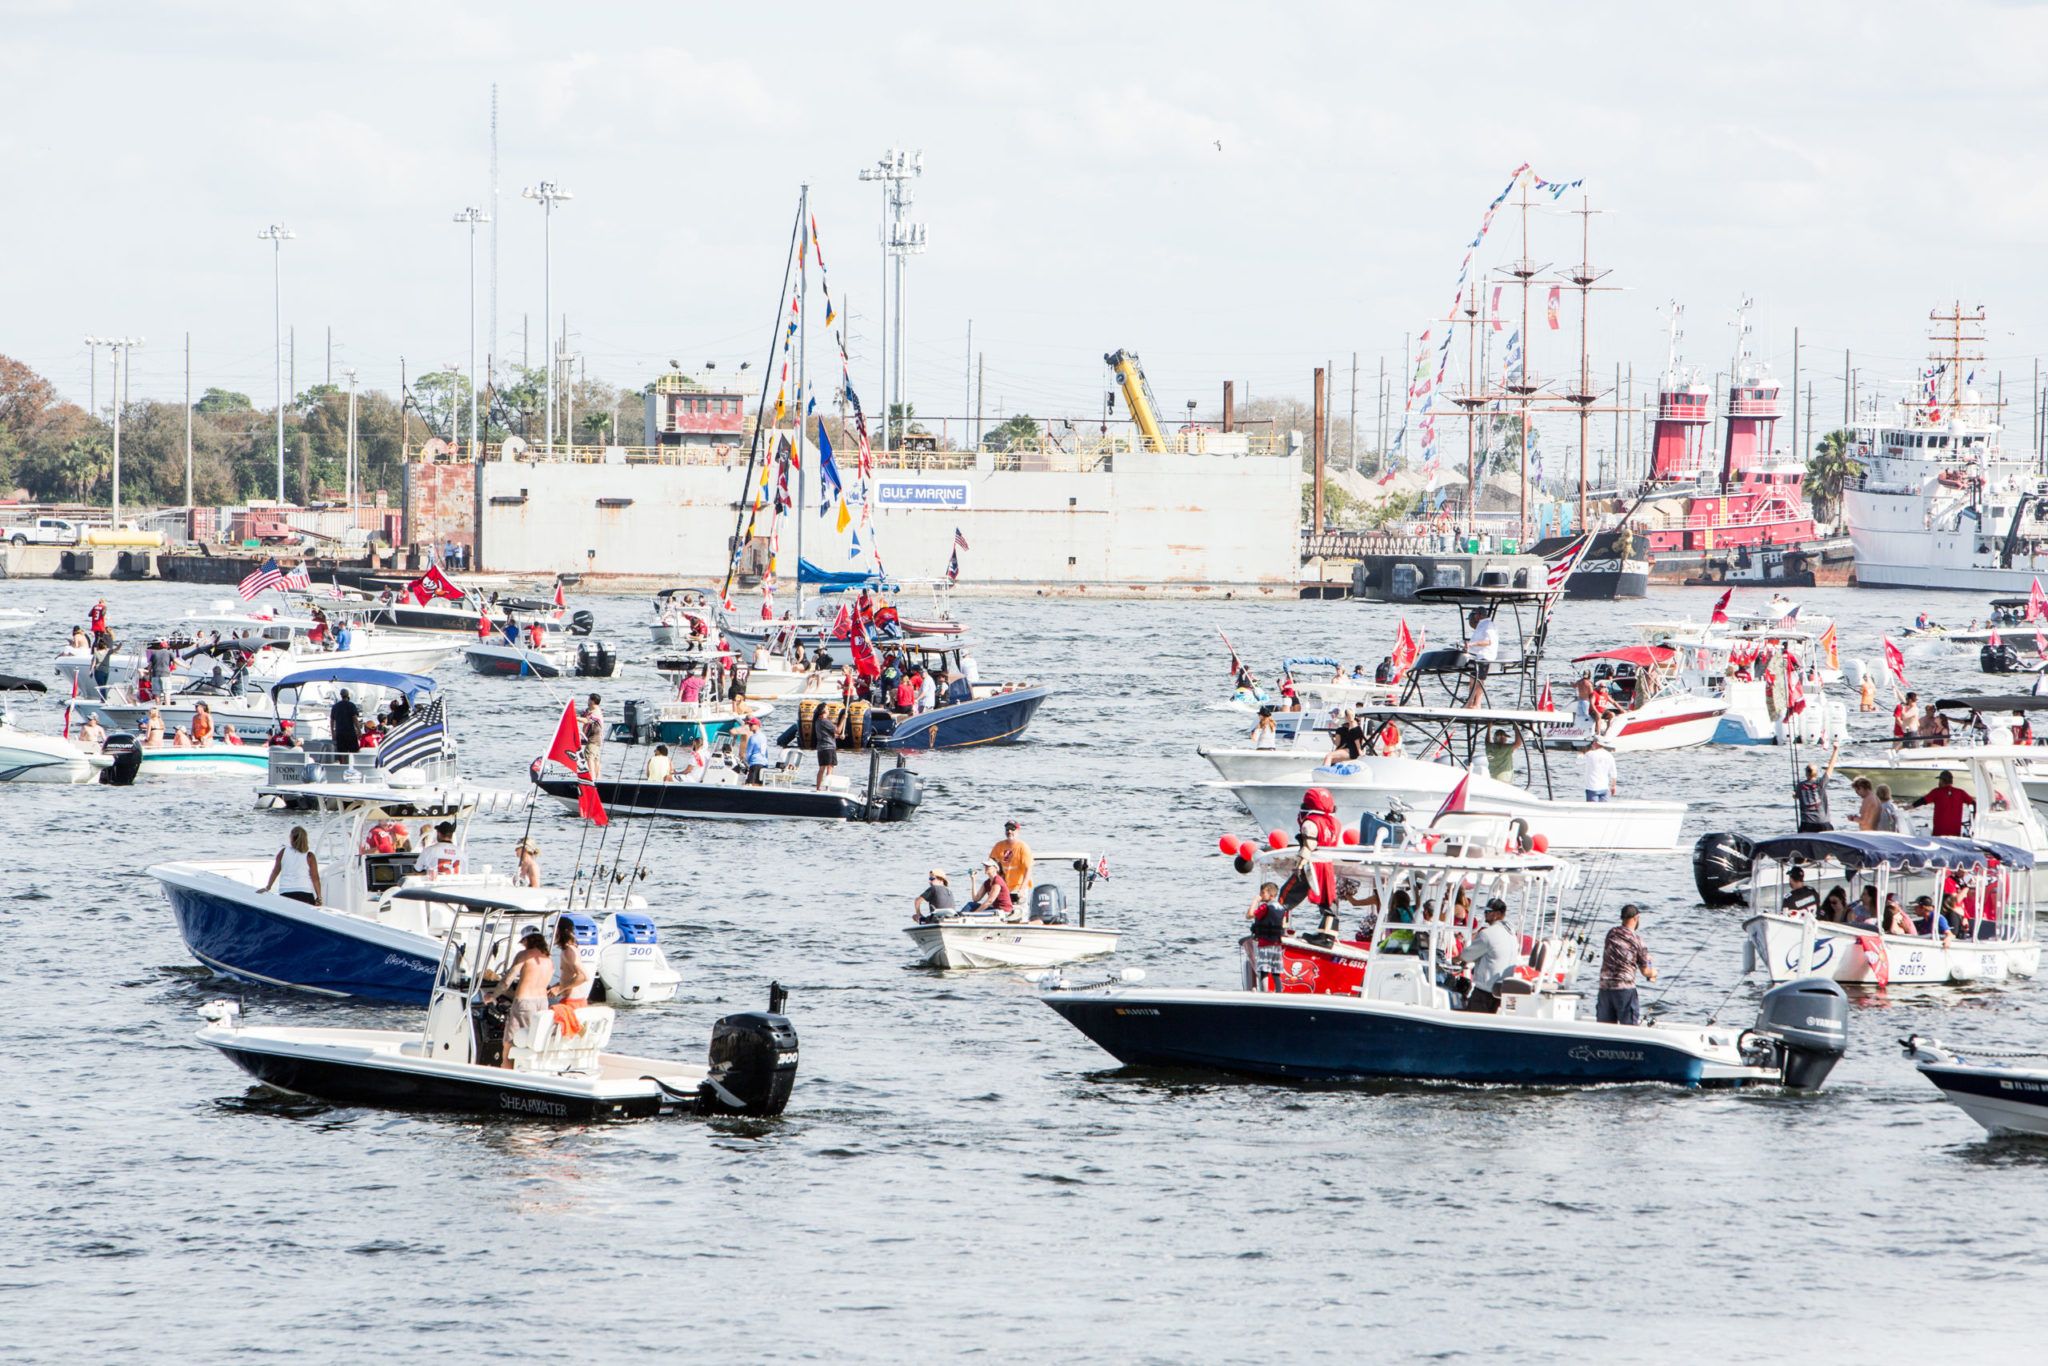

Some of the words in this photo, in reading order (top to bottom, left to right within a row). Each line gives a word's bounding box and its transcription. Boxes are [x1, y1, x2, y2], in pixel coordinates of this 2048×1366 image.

[882, 487, 914, 499] GULF
[915, 488, 964, 500] MARINE
[736, 669, 748, 681] 87
[275, 766, 296, 774] TOON
[282, 773, 300, 781] TIME
[580, 948, 595, 957] 00
[629, 947, 653, 956] 300
[1910, 951, 1923, 963] GO
[1339, 957, 1348, 966] FL
[1898, 964, 1926, 976] BOLTS
[777, 1052, 798, 1065] 300
[500, 1092, 568, 1117] SHEARWATER
